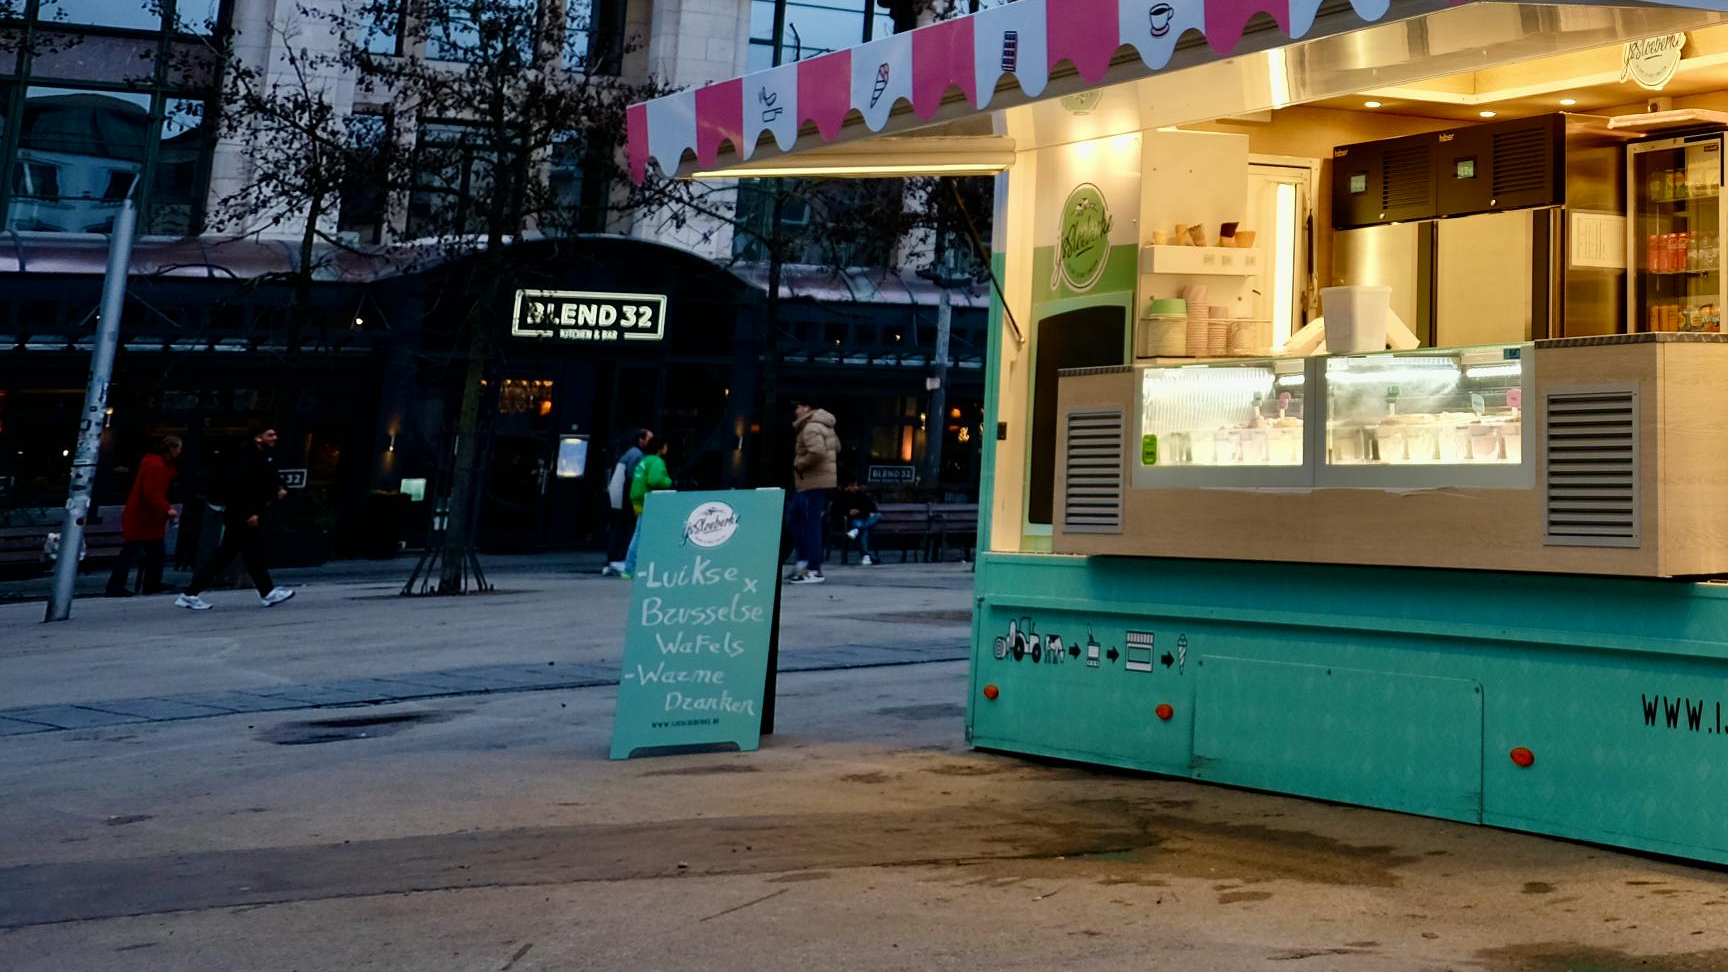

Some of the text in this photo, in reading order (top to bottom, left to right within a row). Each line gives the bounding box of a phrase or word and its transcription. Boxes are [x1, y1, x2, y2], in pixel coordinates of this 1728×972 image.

[526, 301, 653, 329] BLEND 32
[559, 328, 593, 340] KITCHEN
[601, 329, 618, 341] BAR
